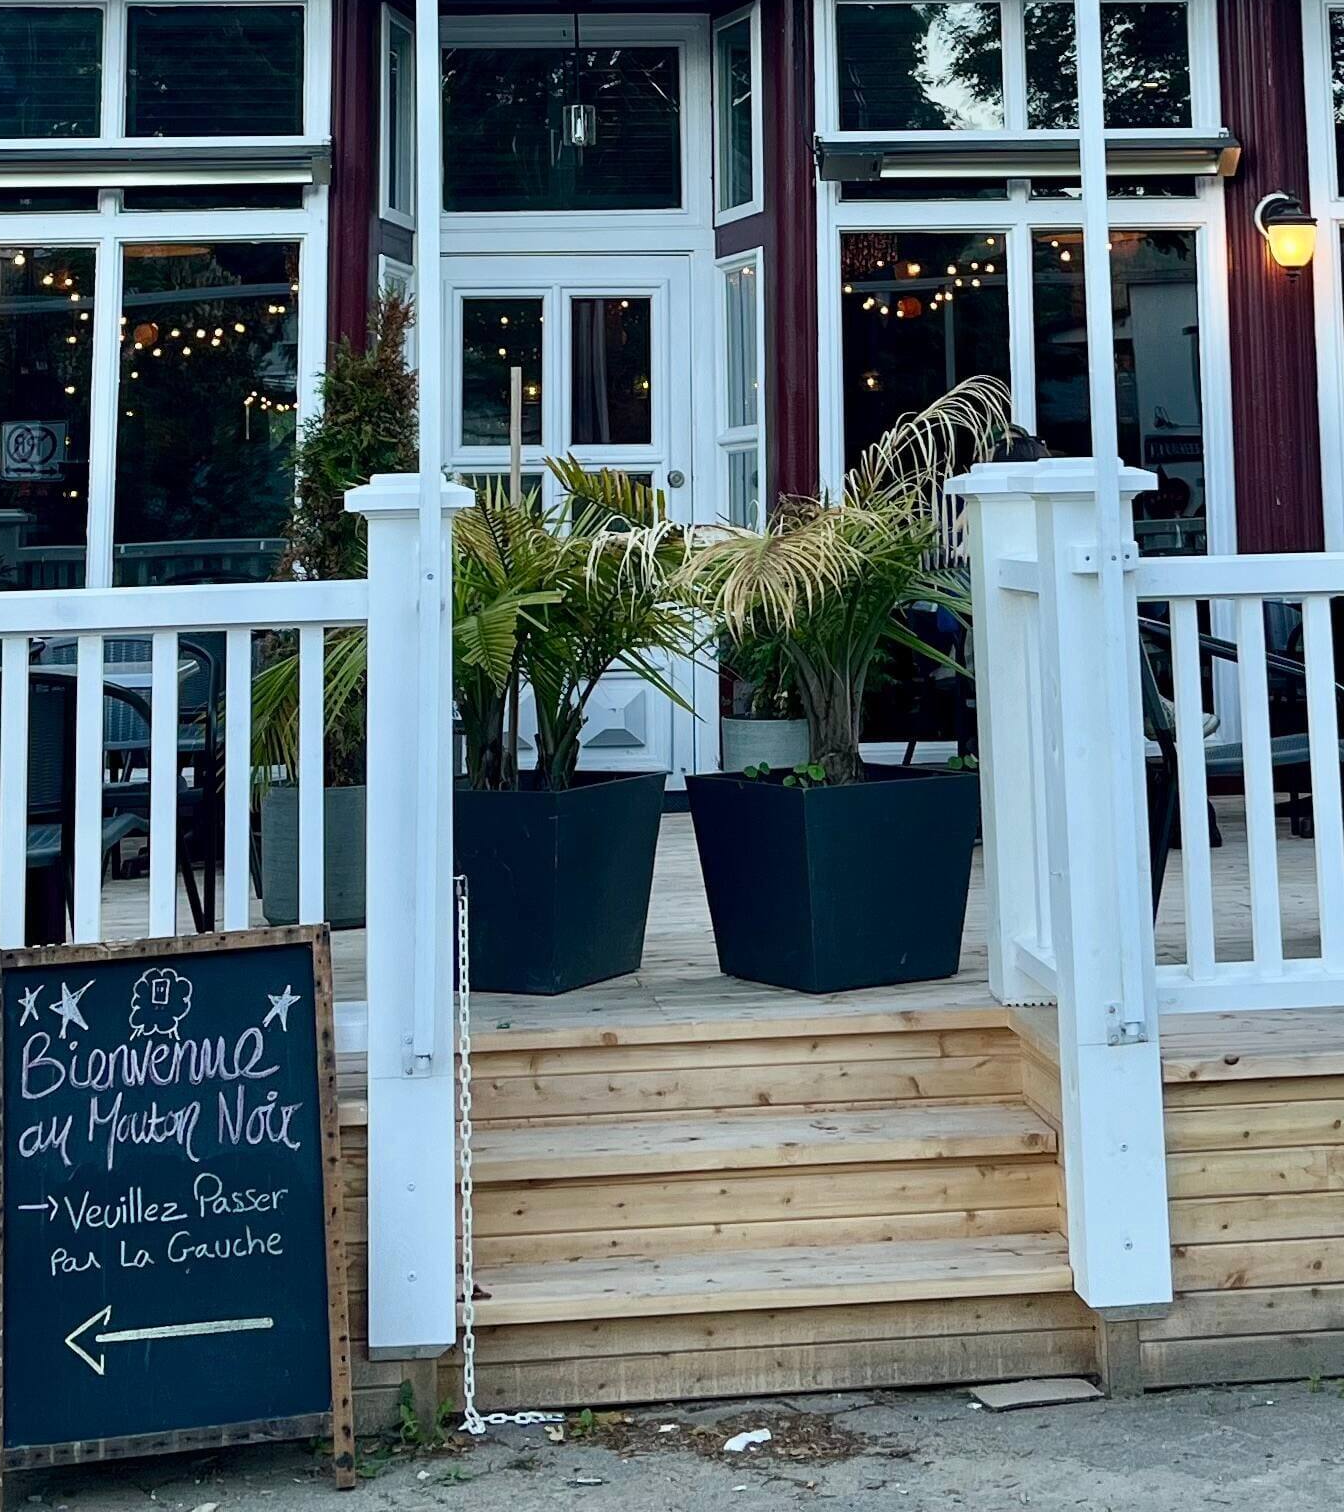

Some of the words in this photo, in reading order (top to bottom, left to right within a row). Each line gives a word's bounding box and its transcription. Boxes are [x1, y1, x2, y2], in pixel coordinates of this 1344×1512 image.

[21, 1026, 280, 1100] Bienvenue
[18, 1113, 74, 1167] au
[88, 1091, 201, 1171] Mouton
[218, 1084, 304, 1151] Noir
[63, 1187, 188, 1233] Veuillez
[193, 1172, 289, 1218] Passer
[120, 1240, 155, 1268] La
[167, 1224, 284, 1263] Gauche
